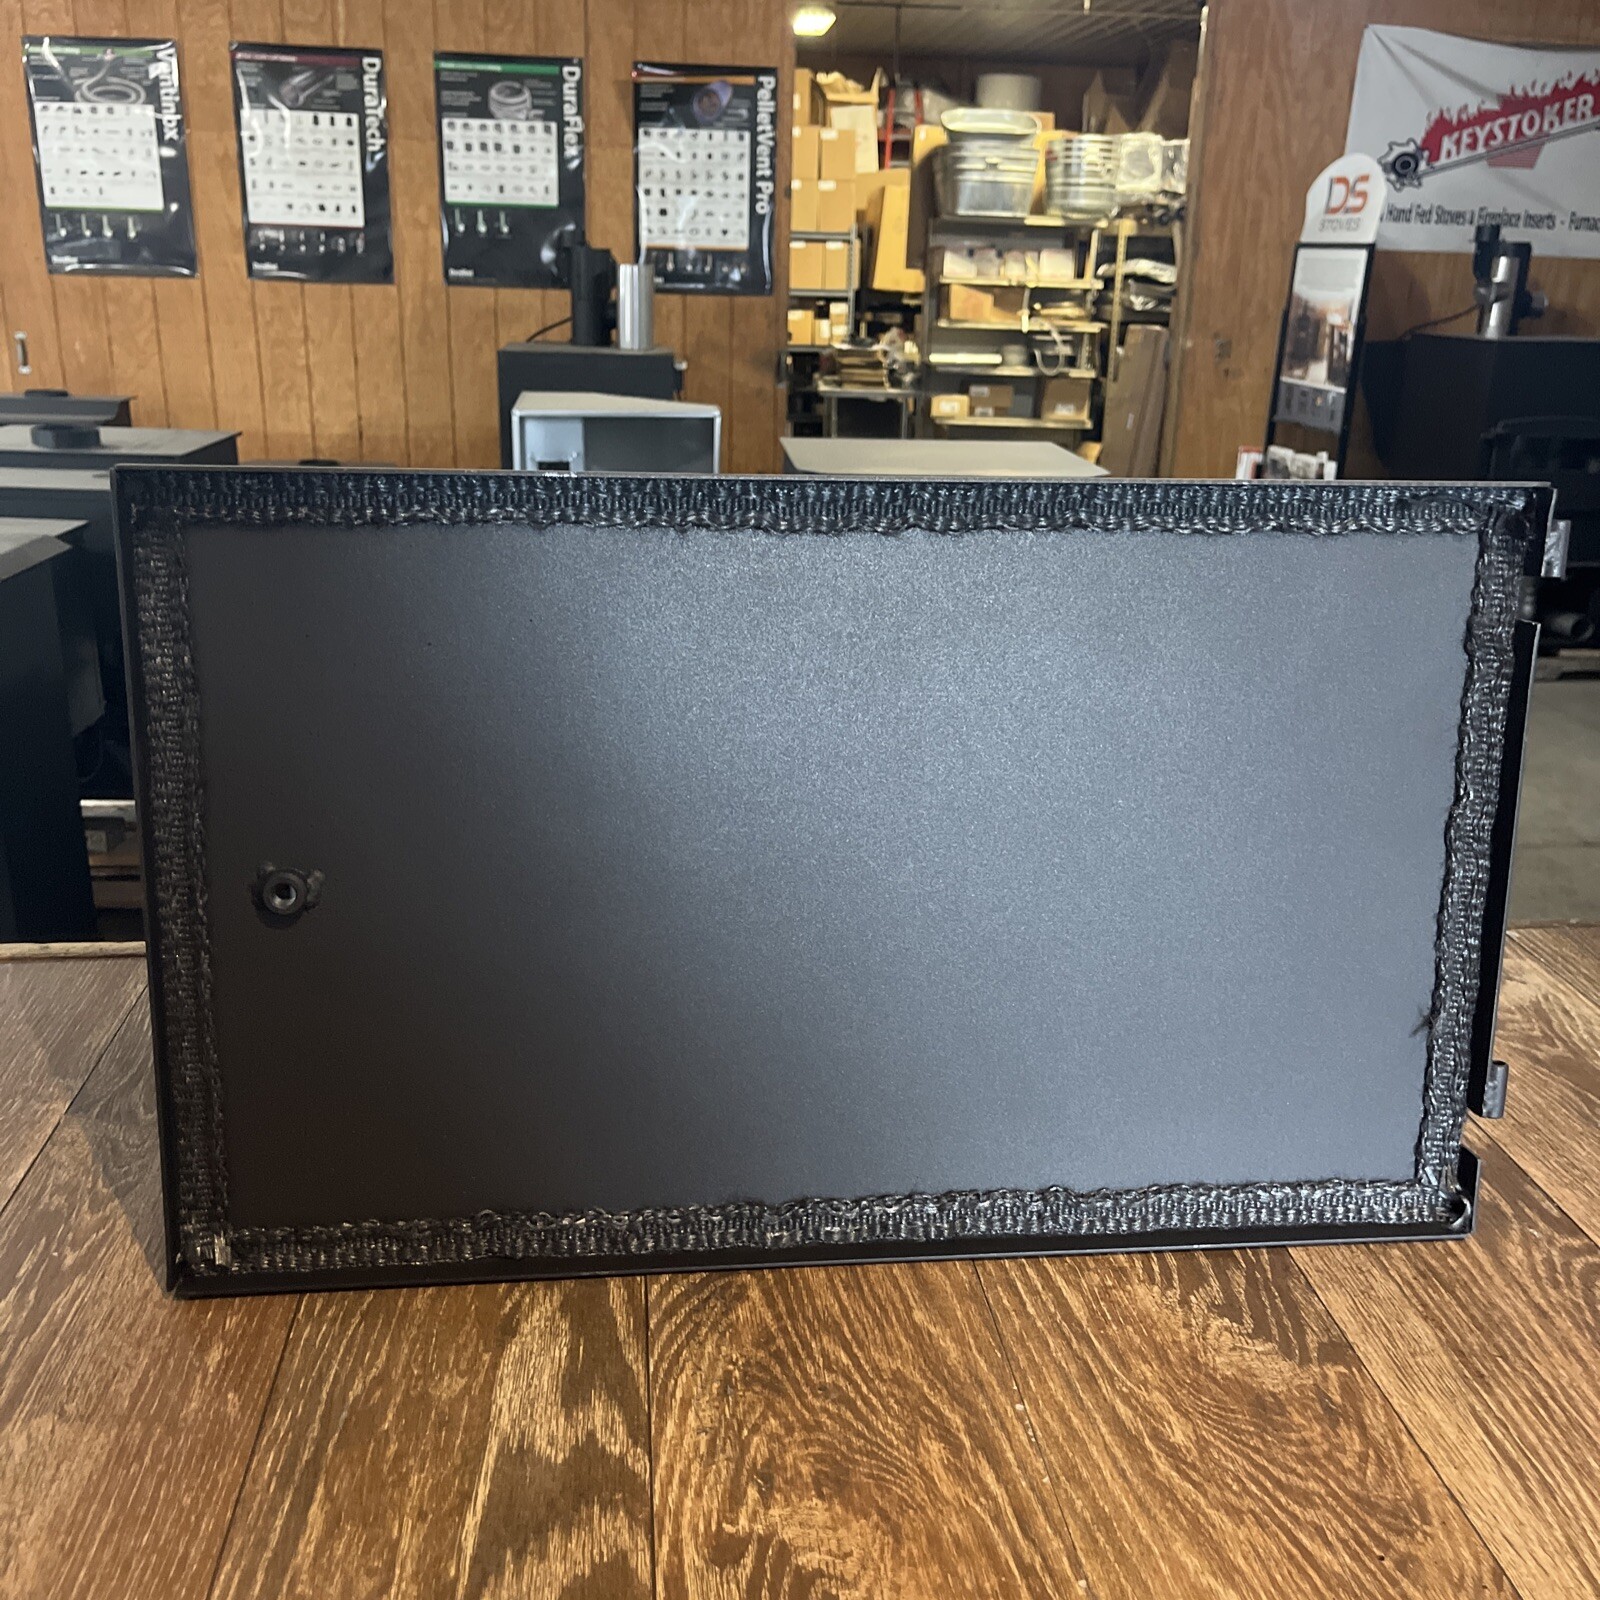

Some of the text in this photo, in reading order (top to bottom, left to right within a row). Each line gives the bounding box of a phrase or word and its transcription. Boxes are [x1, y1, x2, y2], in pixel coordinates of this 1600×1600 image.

[361, 56, 387, 152] DuraTech
[561, 65, 584, 159] DuraFlex
[755, 75, 776, 215] PelletVent Pro
[1437, 93, 1595, 165] KEYSTOKER
[1324, 172, 1370, 215] DS
[1386, 203, 1412, 224] Hand
[1413, 203, 1434, 225] Fed
[1434, 204, 1468, 227] Stoves
[1521, 209, 1557, 231] Inserts
